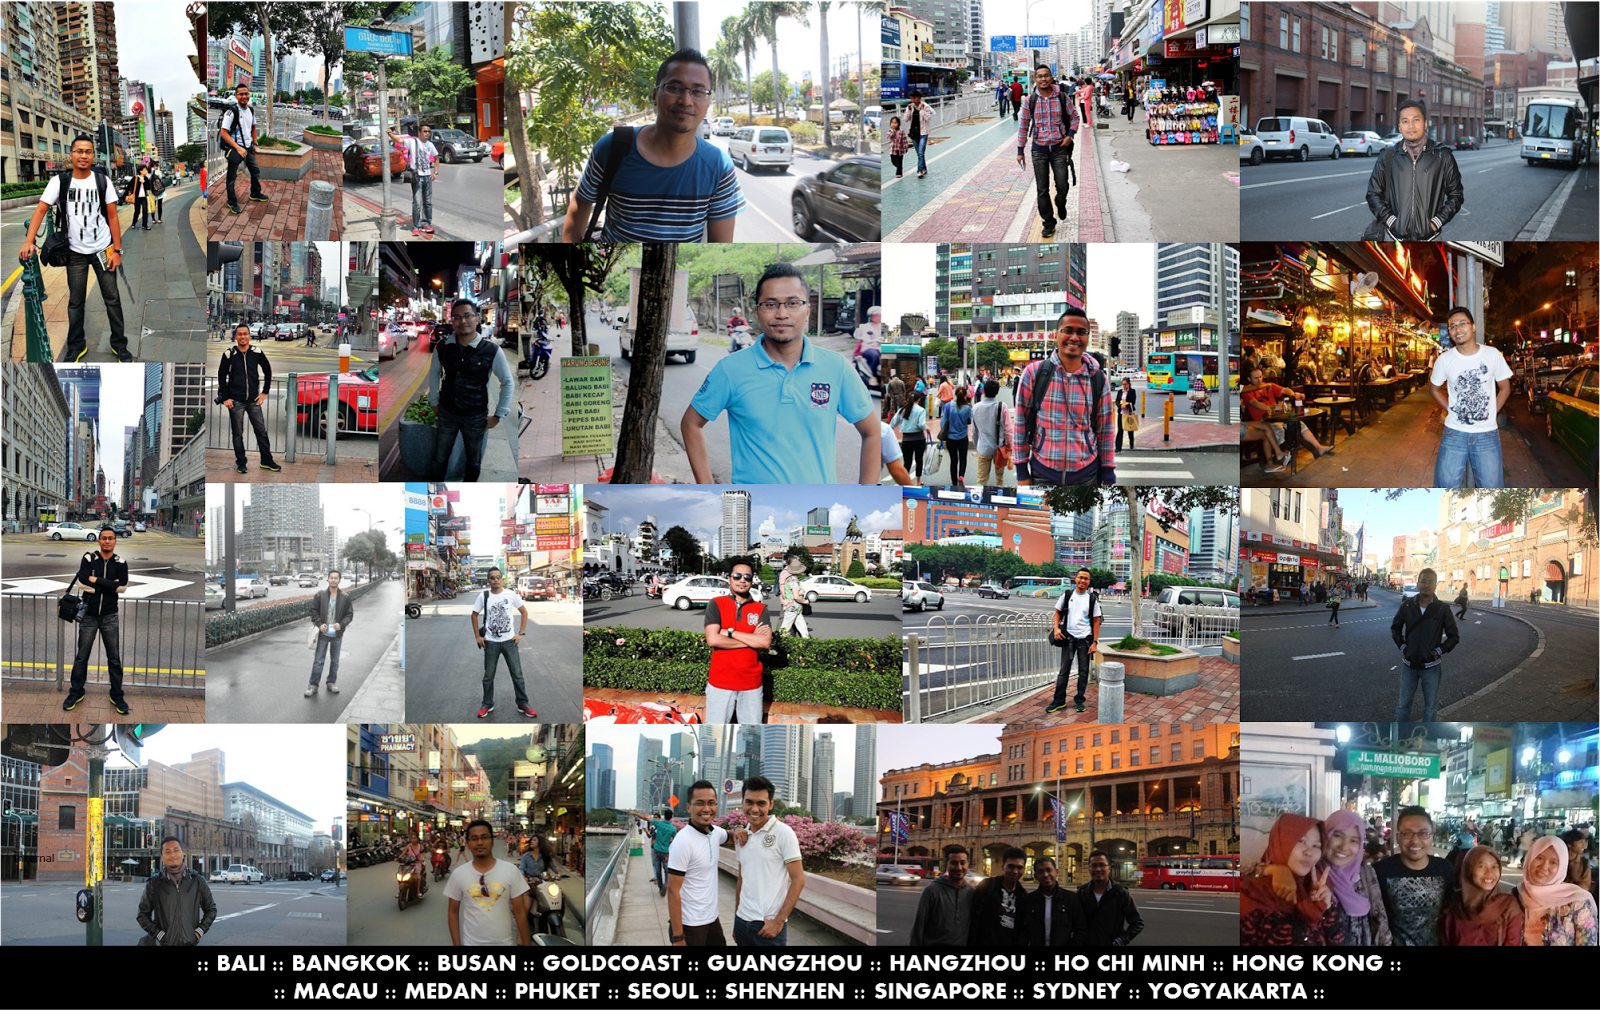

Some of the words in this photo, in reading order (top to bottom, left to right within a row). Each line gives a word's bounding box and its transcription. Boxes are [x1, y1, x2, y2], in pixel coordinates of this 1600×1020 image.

[231, 39, 246, 59] Canon
[562, 358, 588, 367] WARUNG
[590, 357, 610, 367] AGUNG
[408, 496, 427, 507] 8888
[1480, 525, 1498, 540] MARKET
[1275, 537, 1292, 545] oporto
[1279, 555, 1299, 564] oporto
[381, 734, 415, 743] ขายยา
[380, 743, 415, 752] PHARMACY
[1358, 752, 1373, 763] JL.
[1374, 753, 1432, 767] MALIOBORO
